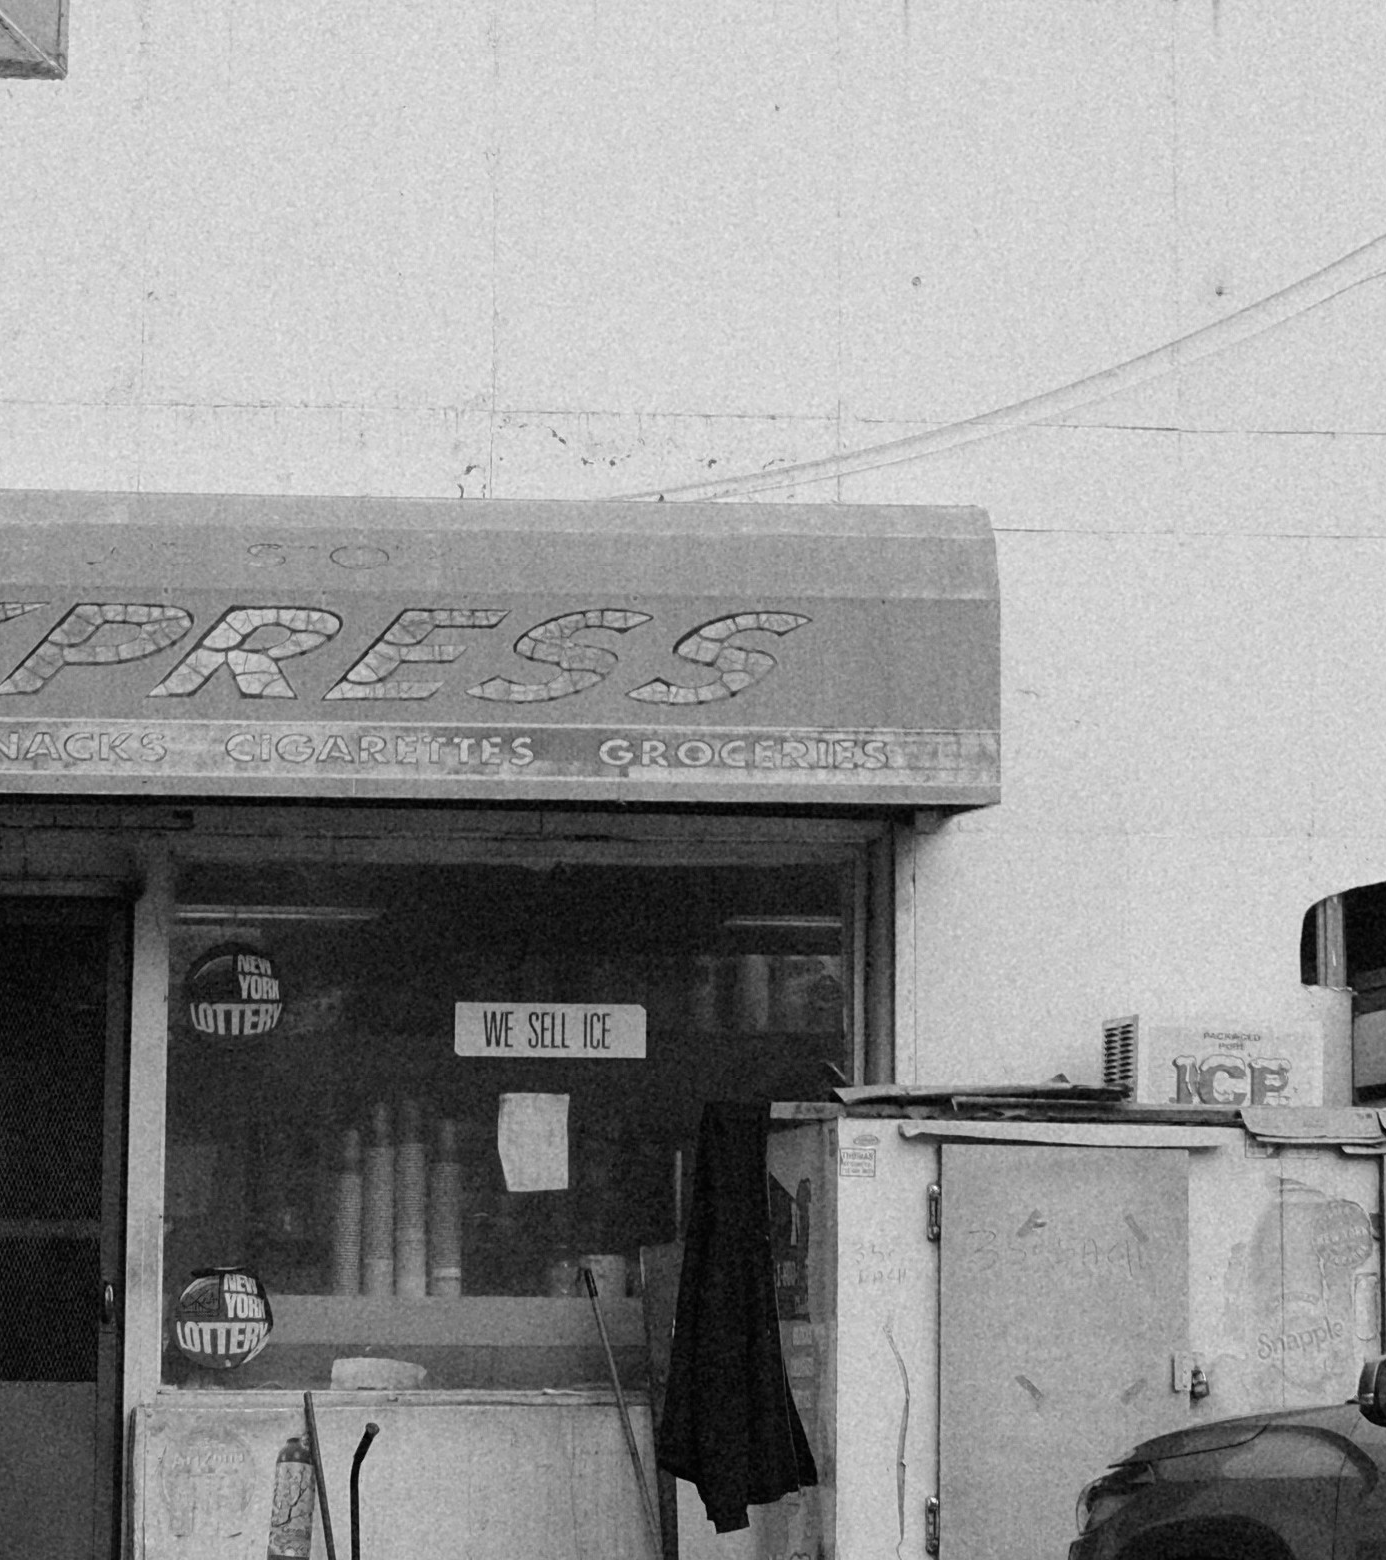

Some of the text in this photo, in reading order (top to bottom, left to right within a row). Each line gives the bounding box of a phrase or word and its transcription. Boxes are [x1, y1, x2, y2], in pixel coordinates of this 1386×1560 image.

[224, 730, 535, 767] CIGARETTES
[598, 737, 890, 770] GROCERIES
[238, 954, 272, 976] NEW
[238, 974, 280, 1000] YORK
[190, 1002, 283, 1036] LOTTERY
[483, 1010, 611, 1050] WE SELL ICE
[1172, 1053, 1293, 1105] ICE
[224, 1273, 258, 1294] NEW
[224, 1292, 266, 1319] YORK
[176, 1321, 269, 1355] LOTTERY
[1257, 1321, 1344, 1360] Snapple
